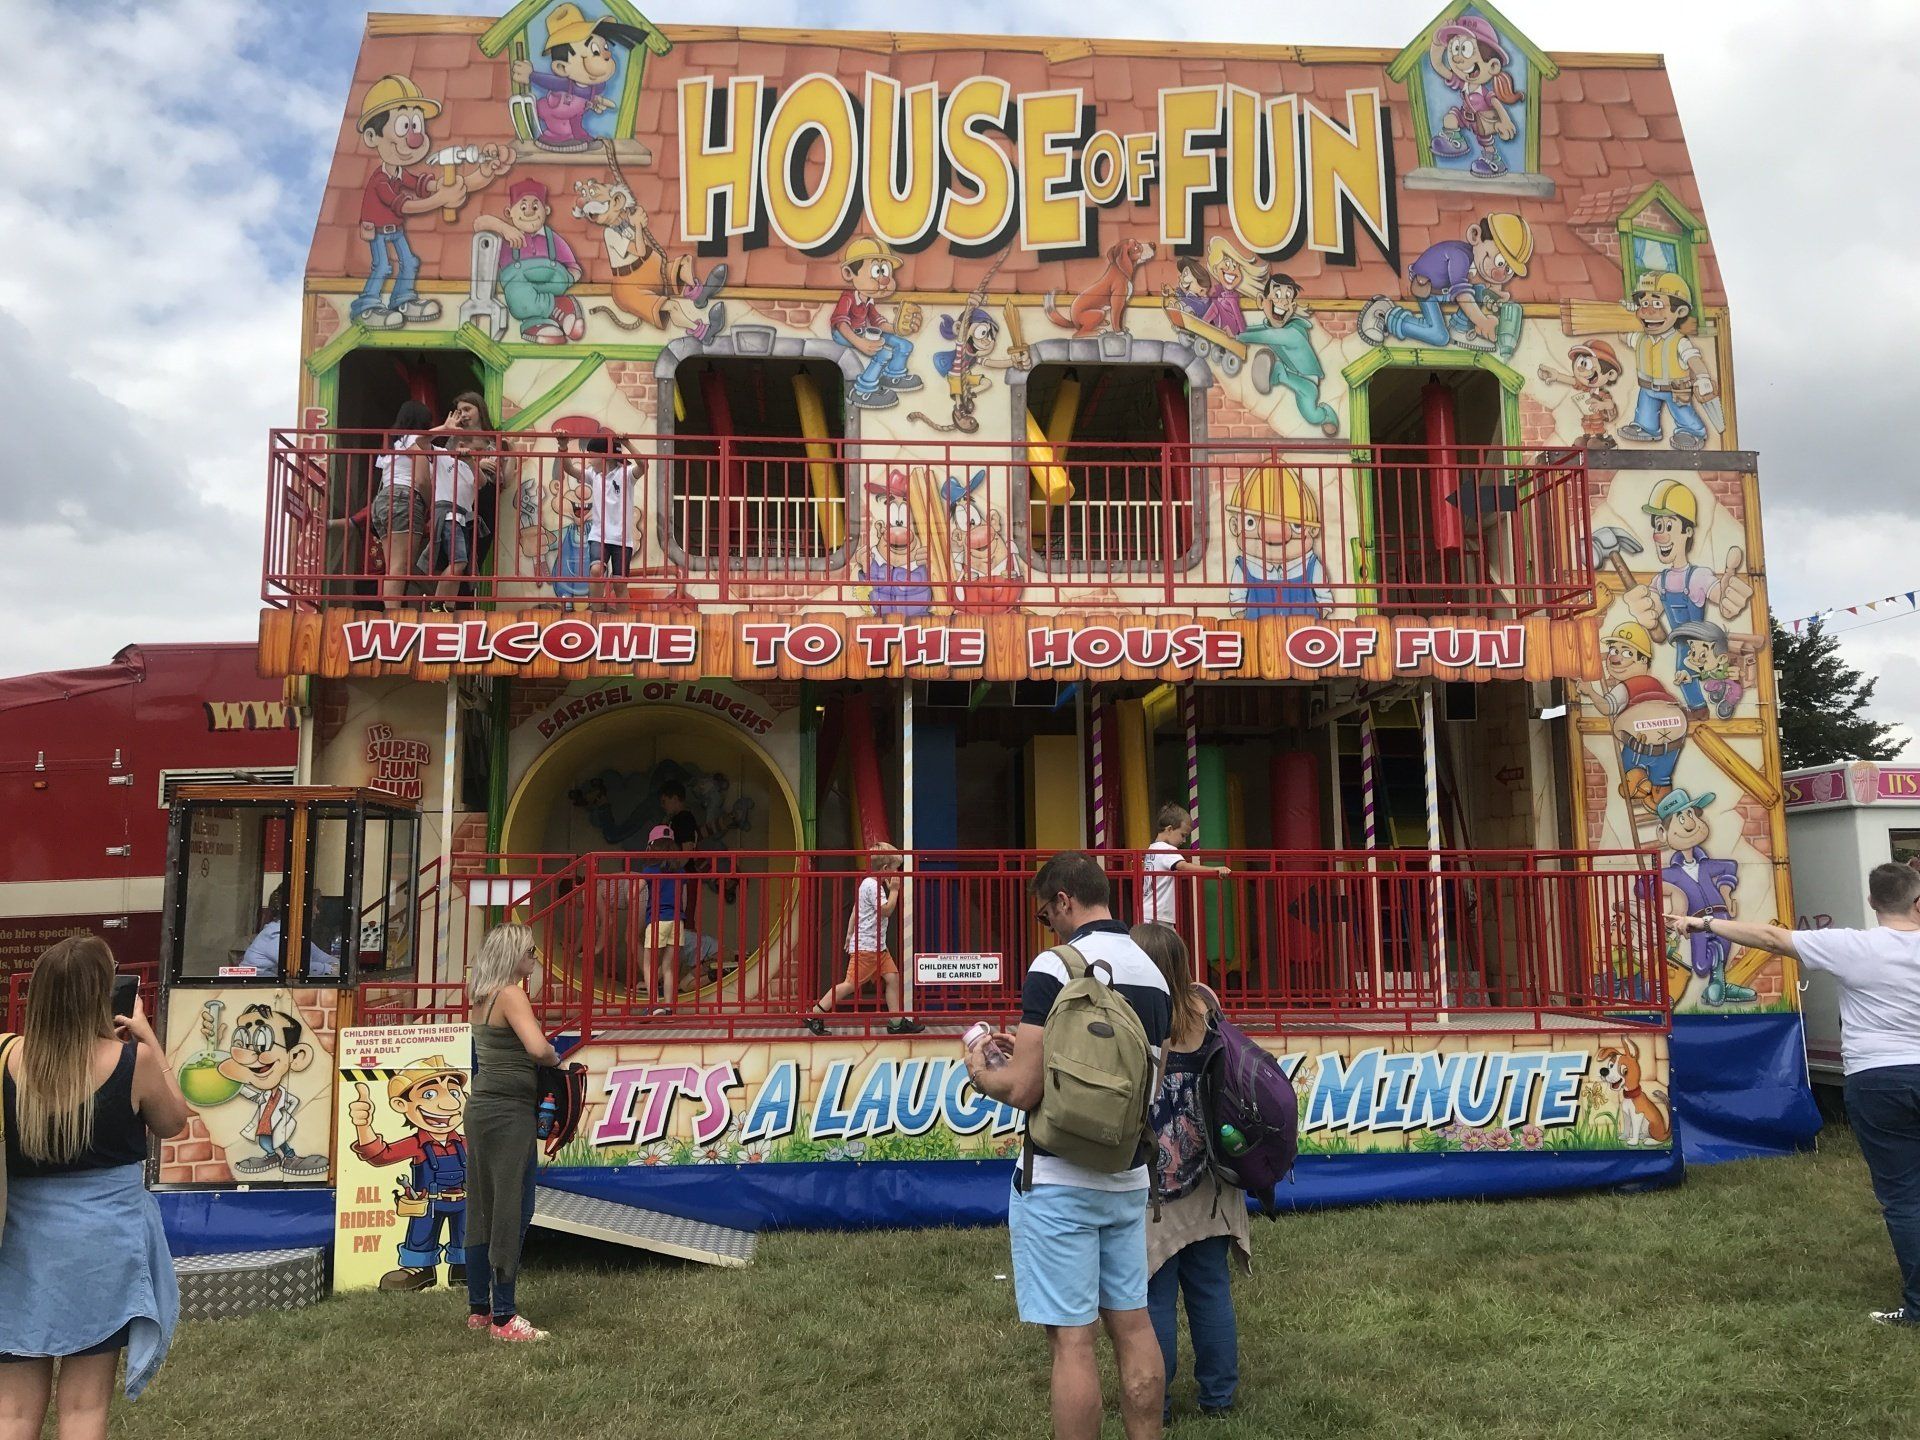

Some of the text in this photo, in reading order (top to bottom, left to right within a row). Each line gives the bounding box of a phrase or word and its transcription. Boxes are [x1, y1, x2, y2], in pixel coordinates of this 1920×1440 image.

[677, 70, 1393, 258] HOUSE OF FUN
[343, 619, 1526, 669] WELCOME TO THE HOUSE OF FUN
[203, 700, 301, 731] WW
[536, 682, 774, 740] BARREL OF LAUGHS
[367, 724, 392, 743] ITS
[1635, 718, 1680, 730] CENSORED
[366, 740, 430, 764] SUPER
[378, 760, 418, 779] FUN
[14, 928, 37, 939] hire
[919, 963, 958, 971] CHILDREN
[948, 971, 982, 979] CARRIED
[343, 1026, 470, 1038] CHILDREN BELOW THIS HEIGHT
[355, 1038, 379, 1046] MUST
[395, 1035, 455, 1045] ACCOMPANIED
[359, 1047, 372, 1055] AN
[373, 1046, 401, 1054] ADULT
[590, 1047, 1594, 1148] IT'S A LAUG MINUTE
[356, 1186, 382, 1204] ALL
[340, 1209, 396, 1229] RIDERS
[353, 1234, 382, 1253] PAY
